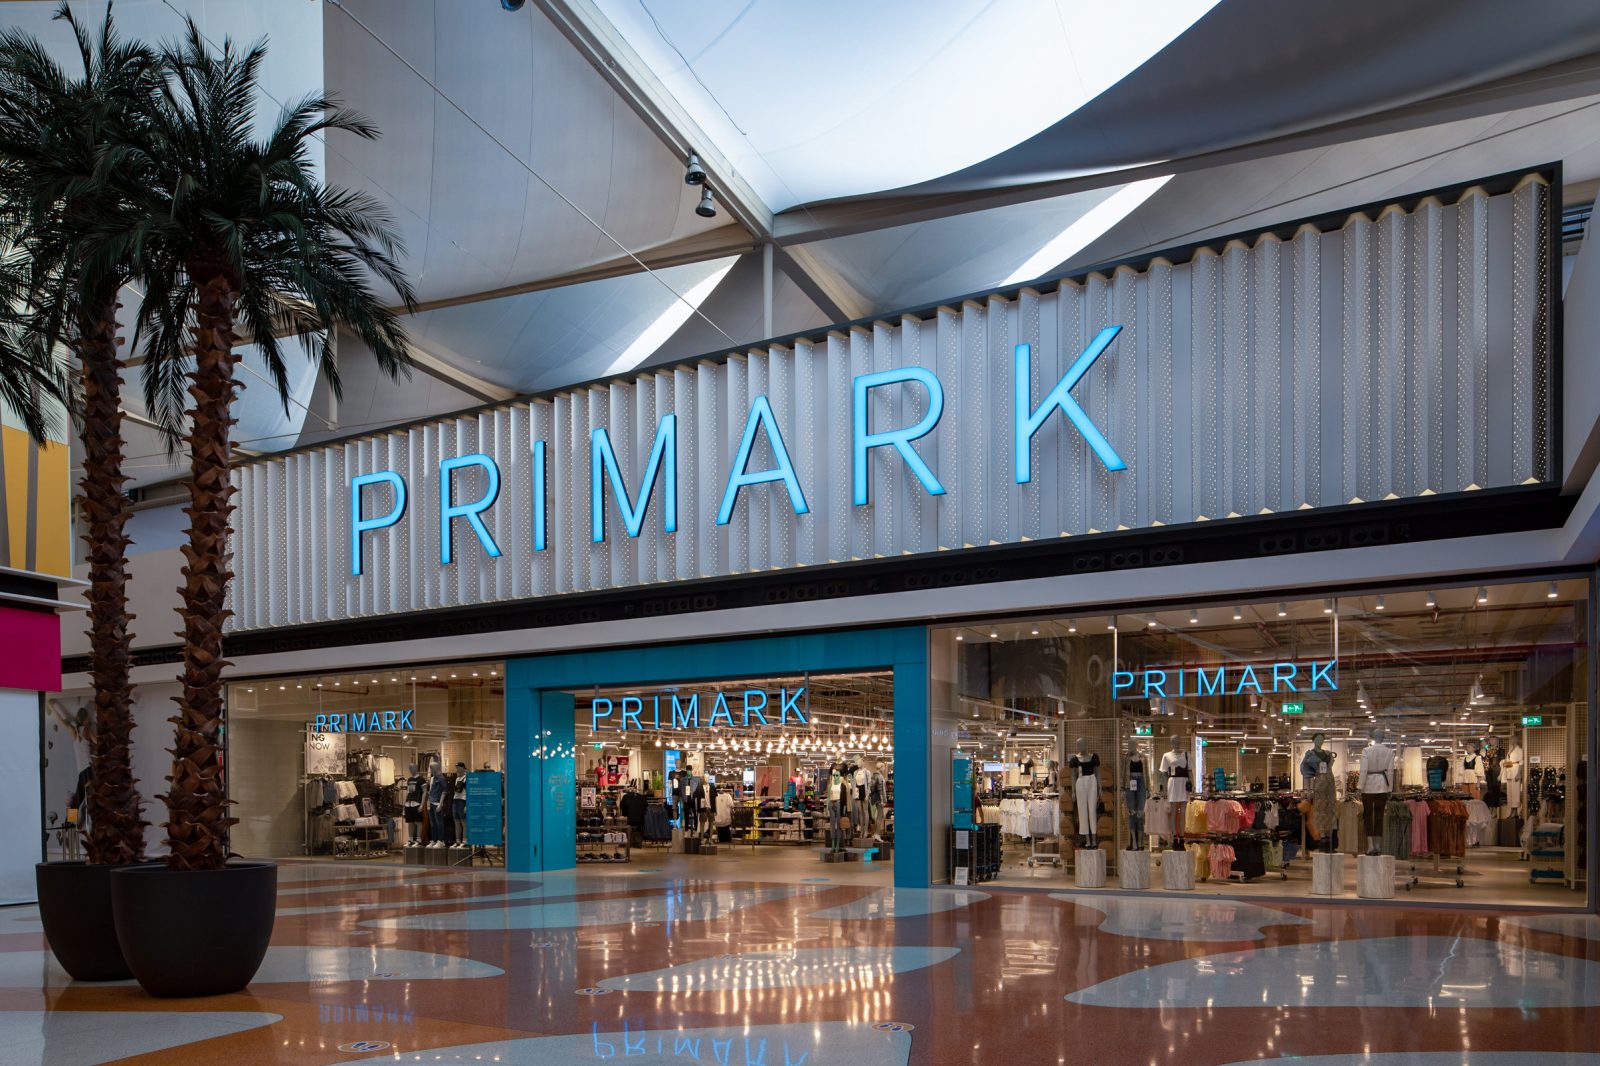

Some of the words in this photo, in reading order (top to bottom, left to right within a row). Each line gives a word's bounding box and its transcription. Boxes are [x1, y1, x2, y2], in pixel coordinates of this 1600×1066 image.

[351, 325, 1127, 577] PRIMARK
[1113, 660, 1338, 700] PRIMARK
[315, 709, 414, 733] PRIMARK
[592, 687, 809, 731] PRIMARK
[309, 742, 330, 751] NOW
